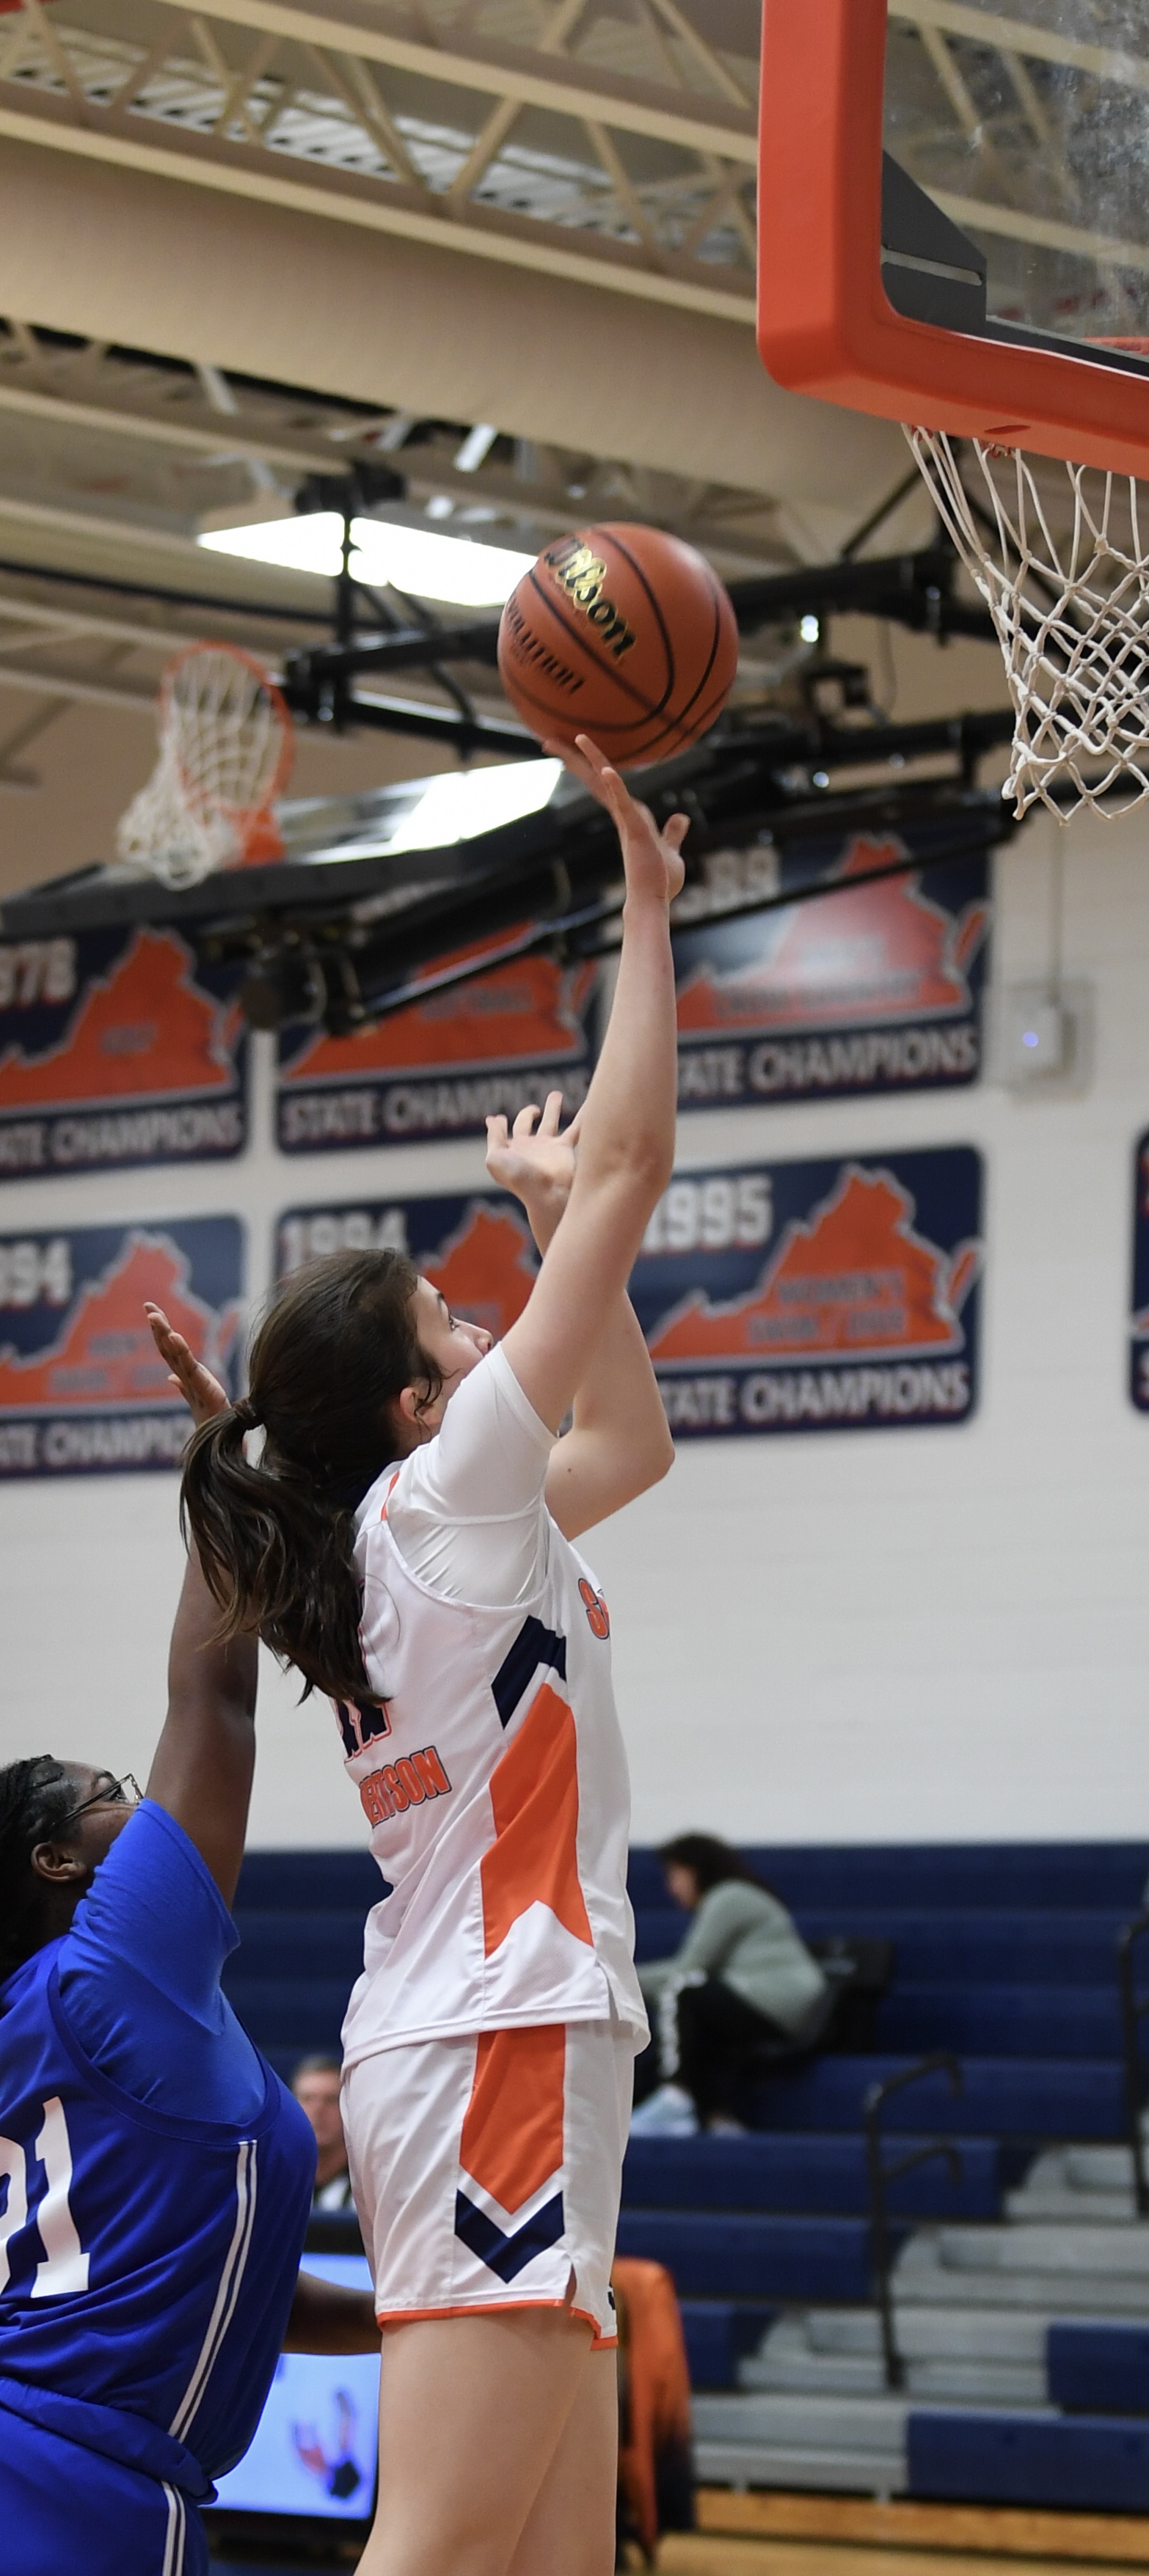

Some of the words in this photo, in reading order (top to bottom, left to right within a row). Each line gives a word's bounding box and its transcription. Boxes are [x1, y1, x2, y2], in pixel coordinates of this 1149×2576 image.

[750, 1024, 977, 1093] CHAMPIONS
[51, 1102, 240, 1160] CHAMPIONS
[284, 1090, 376, 1143] STATE
[639, 1175, 772, 1253] 1995
[741, 1365, 969, 1423] CHAMPIONS
[360, 1745, 451, 1828] ERTSON
